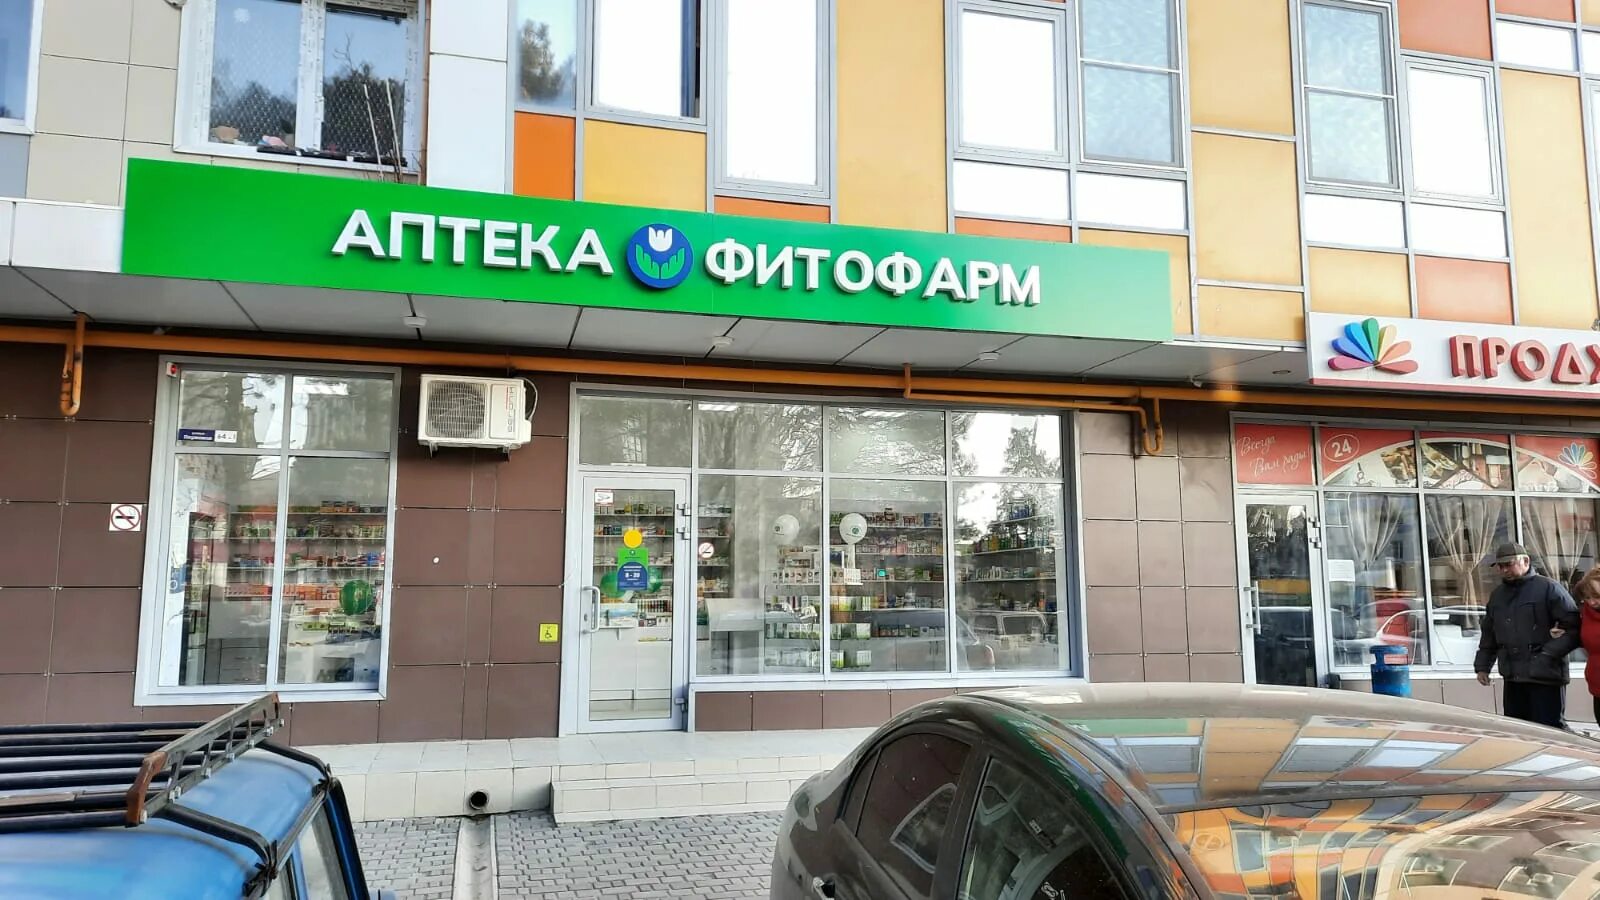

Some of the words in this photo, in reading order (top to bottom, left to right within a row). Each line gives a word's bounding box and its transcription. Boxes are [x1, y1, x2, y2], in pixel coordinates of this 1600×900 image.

[331, 209, 614, 275] АПТЕКА
[704, 238, 1041, 306] ФИТОФАРМ
[1238, 435, 1276, 457] Всегда
[1331, 438, 1353, 458] 24
[1250, 457, 1280, 477] Вам
